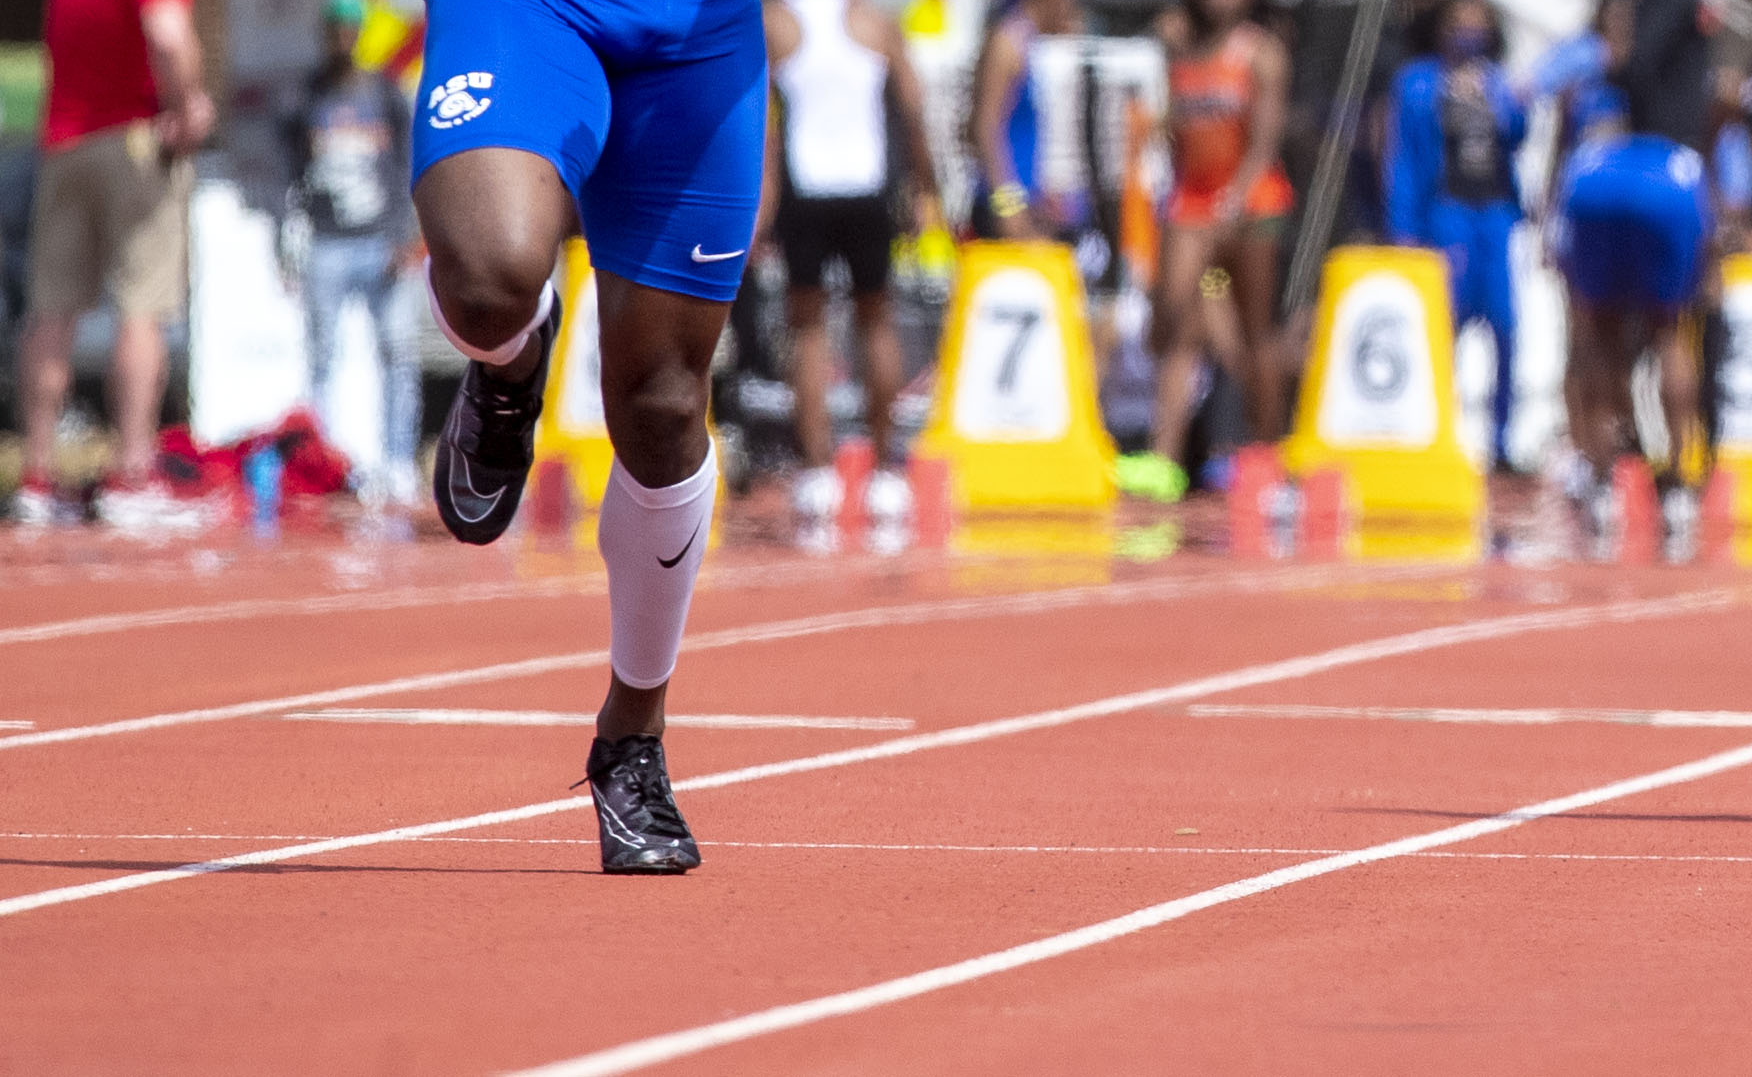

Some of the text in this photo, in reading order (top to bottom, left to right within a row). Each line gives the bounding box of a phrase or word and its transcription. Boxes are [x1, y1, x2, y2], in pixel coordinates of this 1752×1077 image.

[428, 72, 494, 109] ASU
[980, 304, 1043, 392] 7
[1350, 310, 1412, 402] 6
